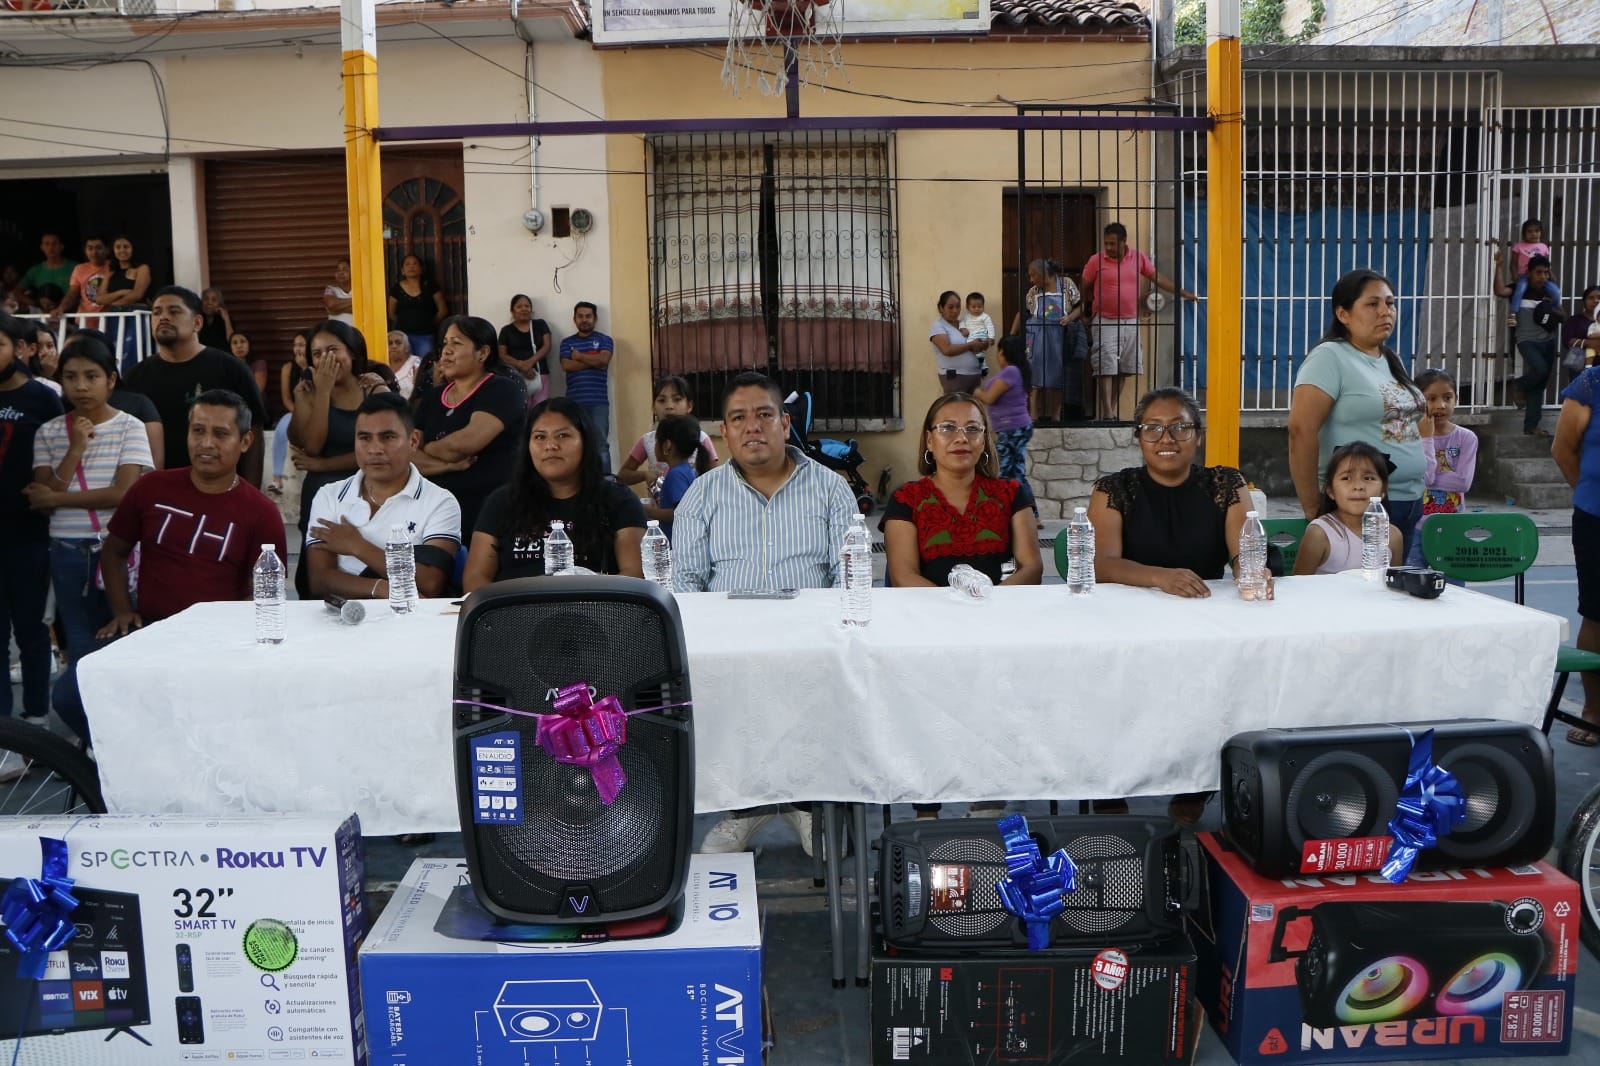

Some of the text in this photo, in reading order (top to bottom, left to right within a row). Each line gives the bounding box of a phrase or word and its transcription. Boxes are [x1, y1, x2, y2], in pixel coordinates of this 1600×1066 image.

[612, 8, 640, 16] SENCILLEZ
[697, 6, 716, 14] TODOS
[0, 405, 24, 420] ster
[155, 503, 235, 562] TH
[1456, 546, 1506, 556] 2018 2021
[81, 849, 194, 870] SPECTRA
[216, 848, 284, 868] Roku
[290, 846, 328, 868] TV
[1317, 842, 1327, 870] URBAN
[1337, 843, 1348, 859] 000
[174, 920, 236, 930] SMART TV
[105, 957, 125, 966] Roku
[1096, 960, 1125, 977] 5 AÑOS
[317, 973, 338, 981] rápida
[388, 1006, 397, 1047] RECARGABLE
[394, 1006, 403, 1042] BATERÍA
[1300, 1015, 1485, 1050] URBAN
[1532, 1012, 1542, 1037] 30 000
[701, 1025, 710, 1066] INALÁMB
